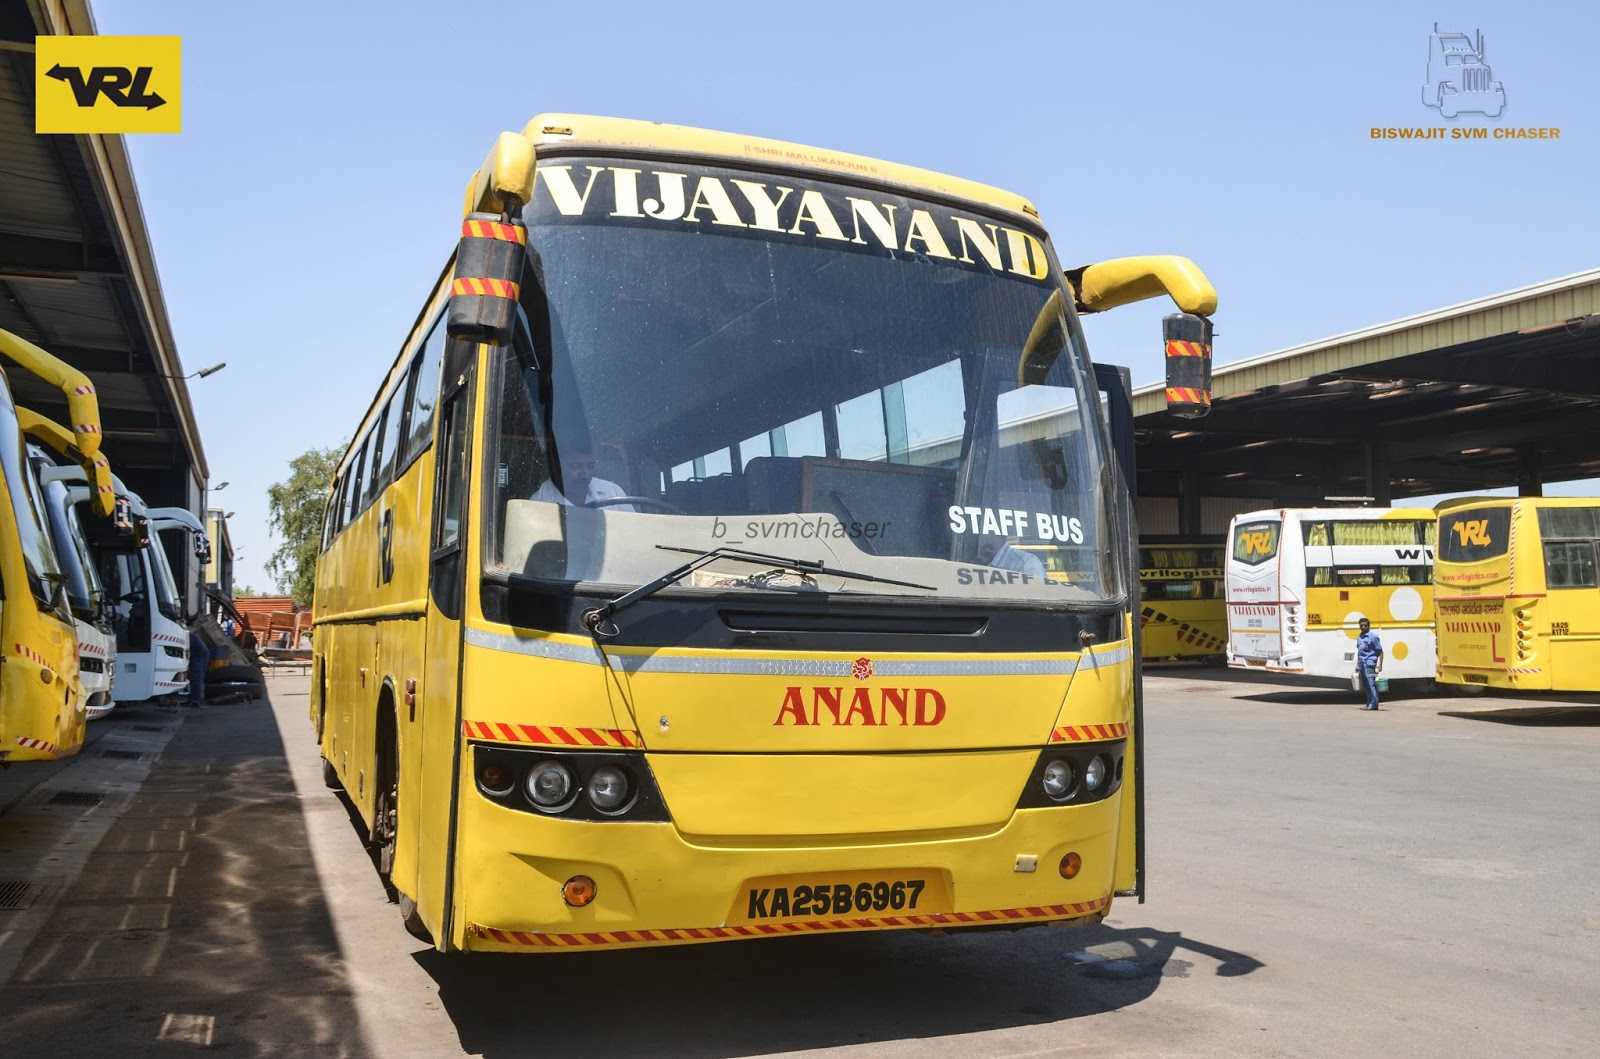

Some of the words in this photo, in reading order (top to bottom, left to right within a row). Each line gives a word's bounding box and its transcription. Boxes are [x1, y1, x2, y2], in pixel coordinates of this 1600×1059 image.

[754, 147, 782, 157] SHRI
[786, 152, 867, 172] MALLIKARJUN
[536, 165, 1050, 281] VIJAYANAND
[949, 505, 1028, 538] STAFF
[1036, 513, 1084, 544] BUS
[1452, 519, 1492, 547] VRL
[1241, 531, 1271, 554] VRL
[1234, 606, 1276, 616] VIJAYANAND
[1446, 622, 1501, 633] VIJAYANAND
[773, 687, 946, 727] ANAND
[747, 880, 925, 919] KA25B6967
